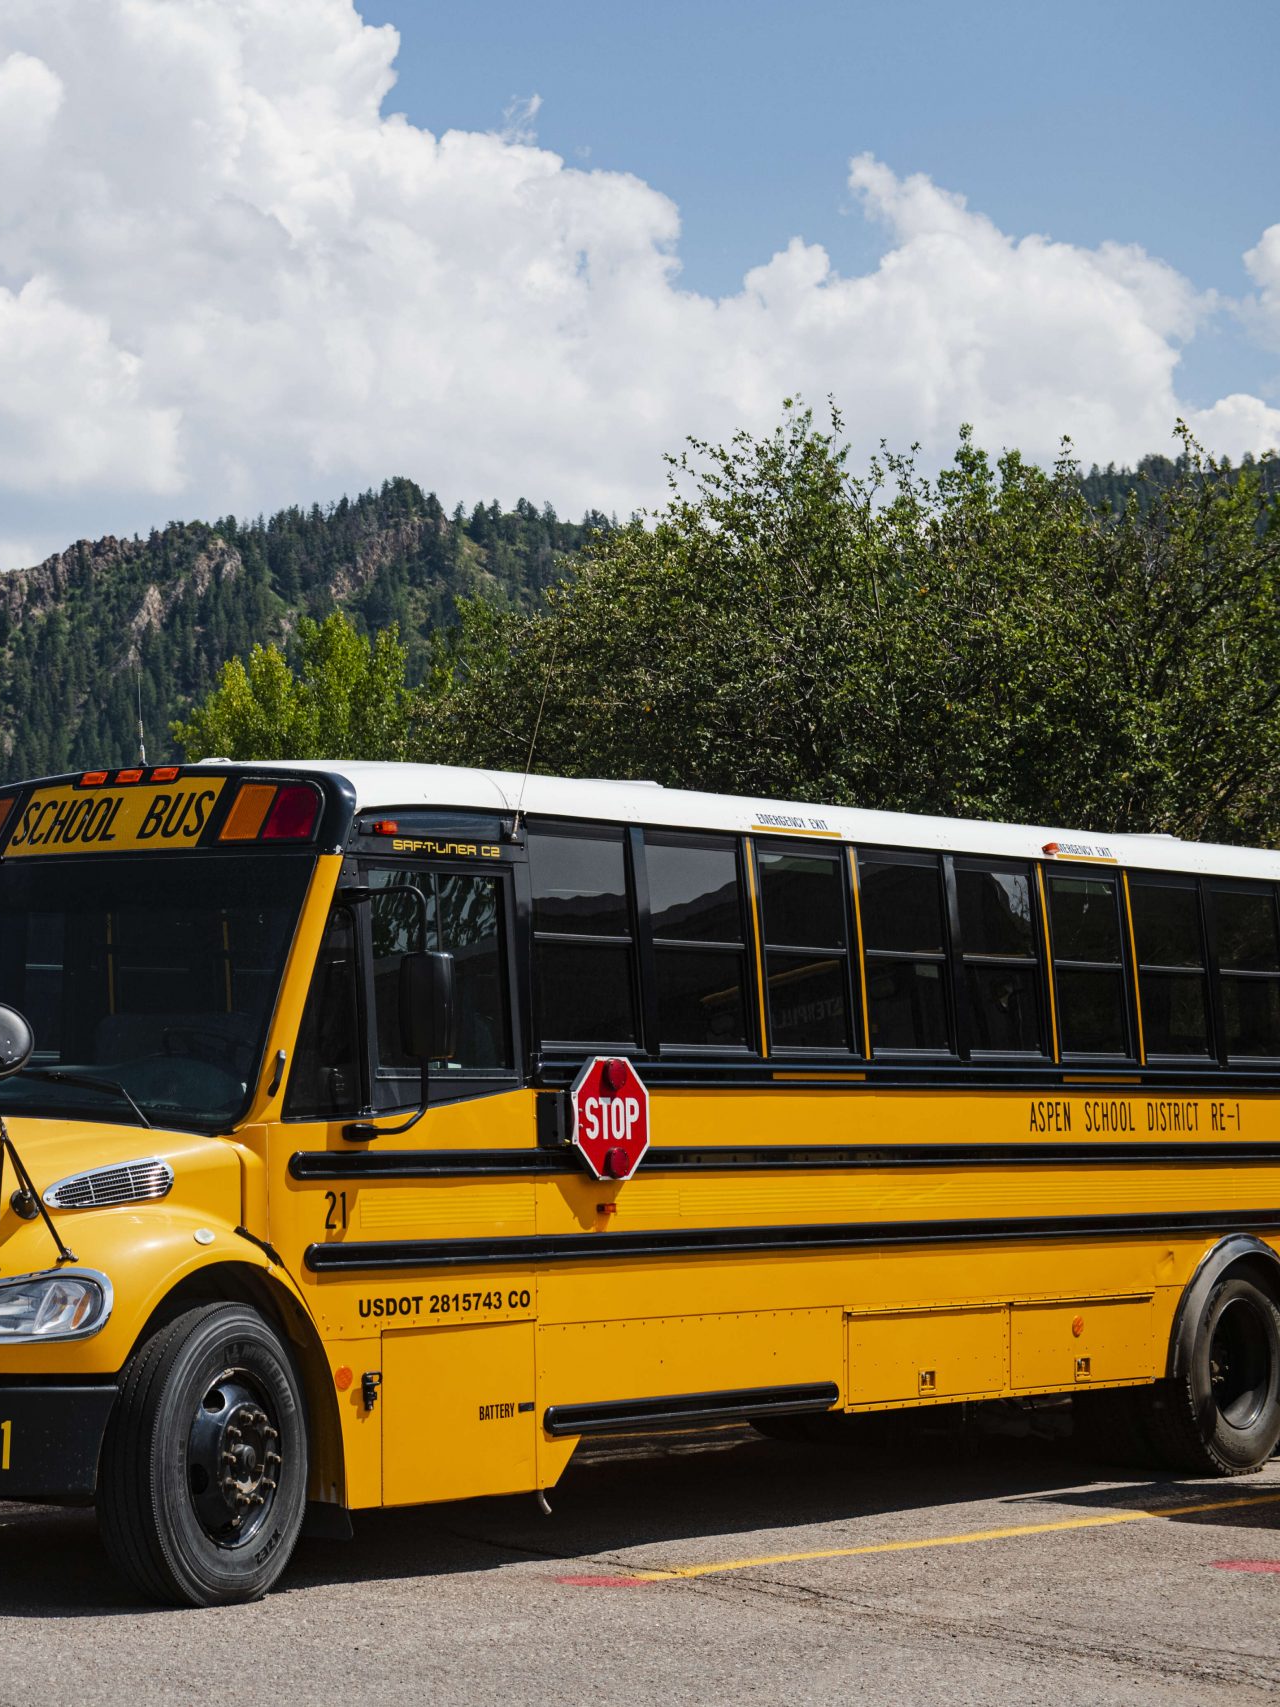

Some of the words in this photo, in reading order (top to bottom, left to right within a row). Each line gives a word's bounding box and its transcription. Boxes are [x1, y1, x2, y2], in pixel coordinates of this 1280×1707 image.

[11, 797, 124, 846] SCHOOL
[136, 790, 216, 840] BUS
[755, 813, 806, 828] EMERGENCY
[808, 818, 828, 830] EXIT
[393, 839, 477, 855] SAF-T-LINER
[481, 846, 500, 857] C2
[1095, 846, 1113, 857] EXIT
[585, 1097, 639, 1140] STOP
[1029, 1101, 1072, 1132] ASPEN
[1084, 1101, 1136, 1132] SCHOOL
[1147, 1102, 1199, 1131] DISTRICT
[1210, 1102, 1241, 1131] RE-1
[325, 1191, 346, 1229] 21
[358, 1295, 424, 1318] USDOT
[429, 1291, 503, 1314] 2815743
[508, 1290, 531, 1308] CO
[479, 1402, 515, 1420] BATTERY
[255, 1527, 282, 1565] XZE2
